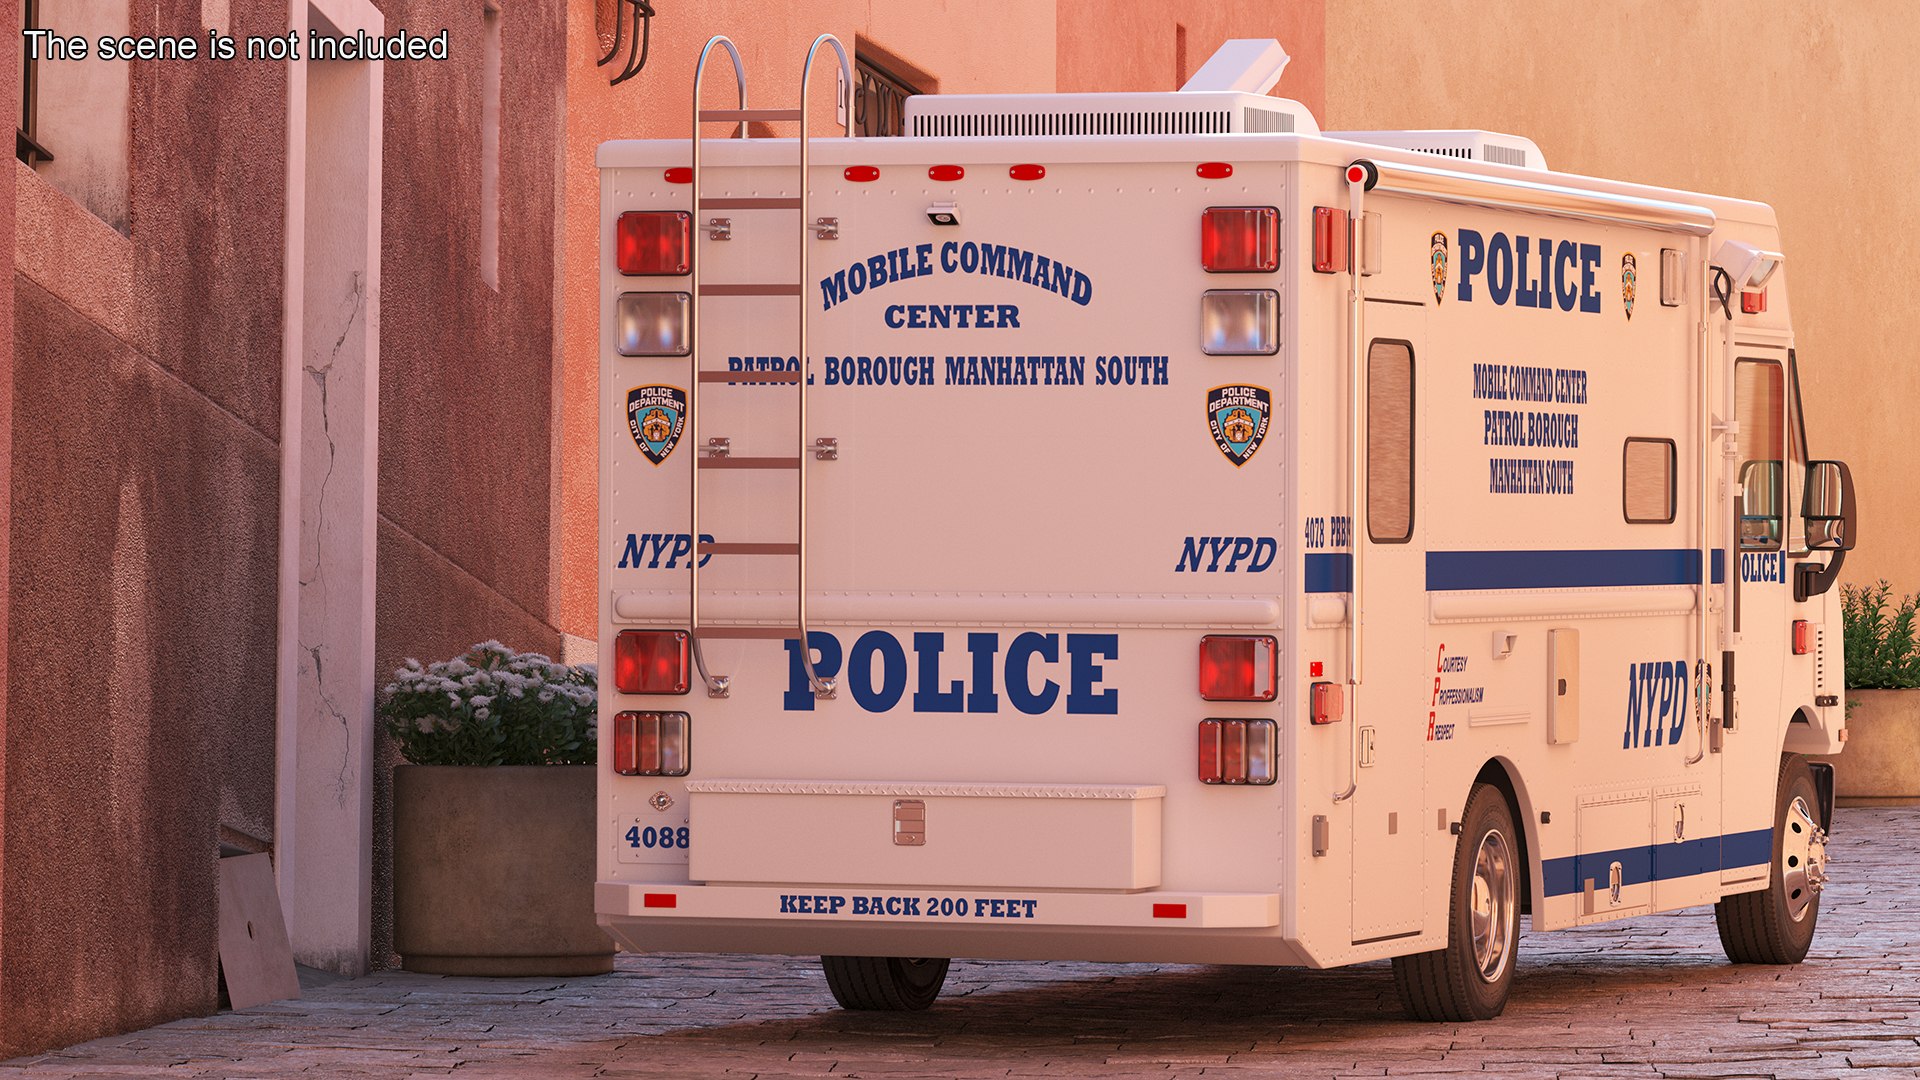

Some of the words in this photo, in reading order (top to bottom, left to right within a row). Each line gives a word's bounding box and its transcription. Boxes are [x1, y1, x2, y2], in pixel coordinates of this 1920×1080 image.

[820, 243, 933, 312] MOBILE
[940, 241, 1093, 307] COMMAND
[1457, 228, 1601, 314] POLICE
[884, 304, 1021, 329] CENTER
[824, 356, 935, 386] BOROUGH
[945, 356, 1085, 386] MANHATTAN
[1095, 355, 1169, 386] SOUTH
[1473, 363, 1507, 400] MOBILE
[1509, 365, 1553, 403] COMMAND
[1555, 368, 1587, 405] CENTER
[629, 396, 685, 413] DEPARTMENT
[640, 387, 673, 399] POLICE
[1209, 396, 1269, 413] DEPARTMENT
[1221, 387, 1257, 399] POLICE
[629, 419, 642, 441] CITY
[639, 442, 650, 453] OF
[660, 440, 675, 458] NEW
[672, 416, 685, 439] YORK
[1210, 420, 1223, 441] CITY
[1220, 442, 1231, 454] OF
[1242, 441, 1258, 460] NEW
[1256, 416, 1269, 439] YORK
[1484, 410, 1526, 447] PATROL
[1527, 412, 1579, 449] BOROUGH
[1489, 458, 1545, 495] MANHATTAN
[1546, 459, 1574, 495] SOUTH
[1304, 516, 1325, 549] 4078
[1175, 536, 1278, 573] NYPD
[1741, 552, 1777, 583] OLICE
[783, 630, 1119, 715] POLICE
[1437, 643, 1468, 673] COURTESY
[1622, 660, 1688, 750] NYPD
[625, 826, 690, 849] 4088
[780, 895, 846, 914] KEEP
[852, 896, 921, 916] BACK
[926, 897, 969, 917] 200
[974, 898, 1038, 919] FEET
